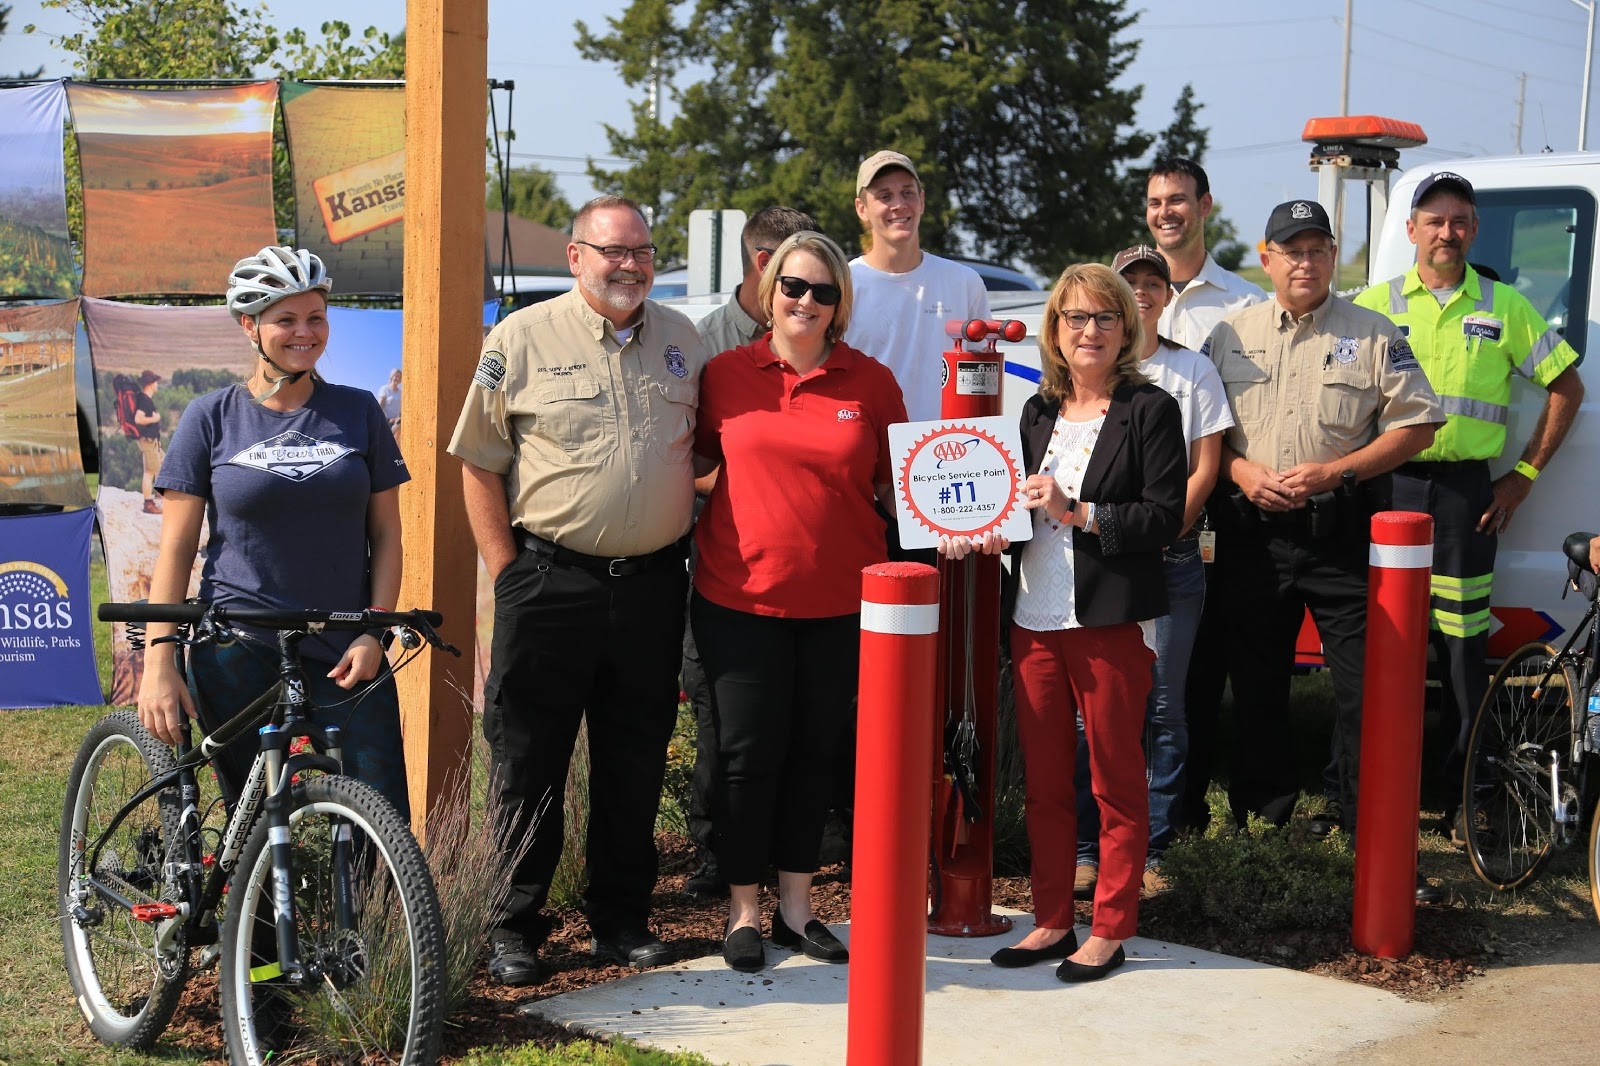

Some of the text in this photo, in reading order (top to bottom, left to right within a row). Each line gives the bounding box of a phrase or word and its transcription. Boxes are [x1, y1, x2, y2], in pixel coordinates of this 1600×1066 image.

[977, 364, 998, 373] fixit
[249, 447, 336, 461] FIND Your TRAIL
[933, 441, 967, 461] AAA
[913, 468, 1006, 483] Bicycle Service Point
[938, 481, 977, 504] #T1
[932, 503, 996, 515] 1-800-222-4357
[330, 612, 362, 620] JONES
[1, 635, 81, 649] Wildlife, Parks
[0, 650, 35, 662] ourism
[231, 812, 253, 850] GARY
[272, 866, 292, 923] FOX
